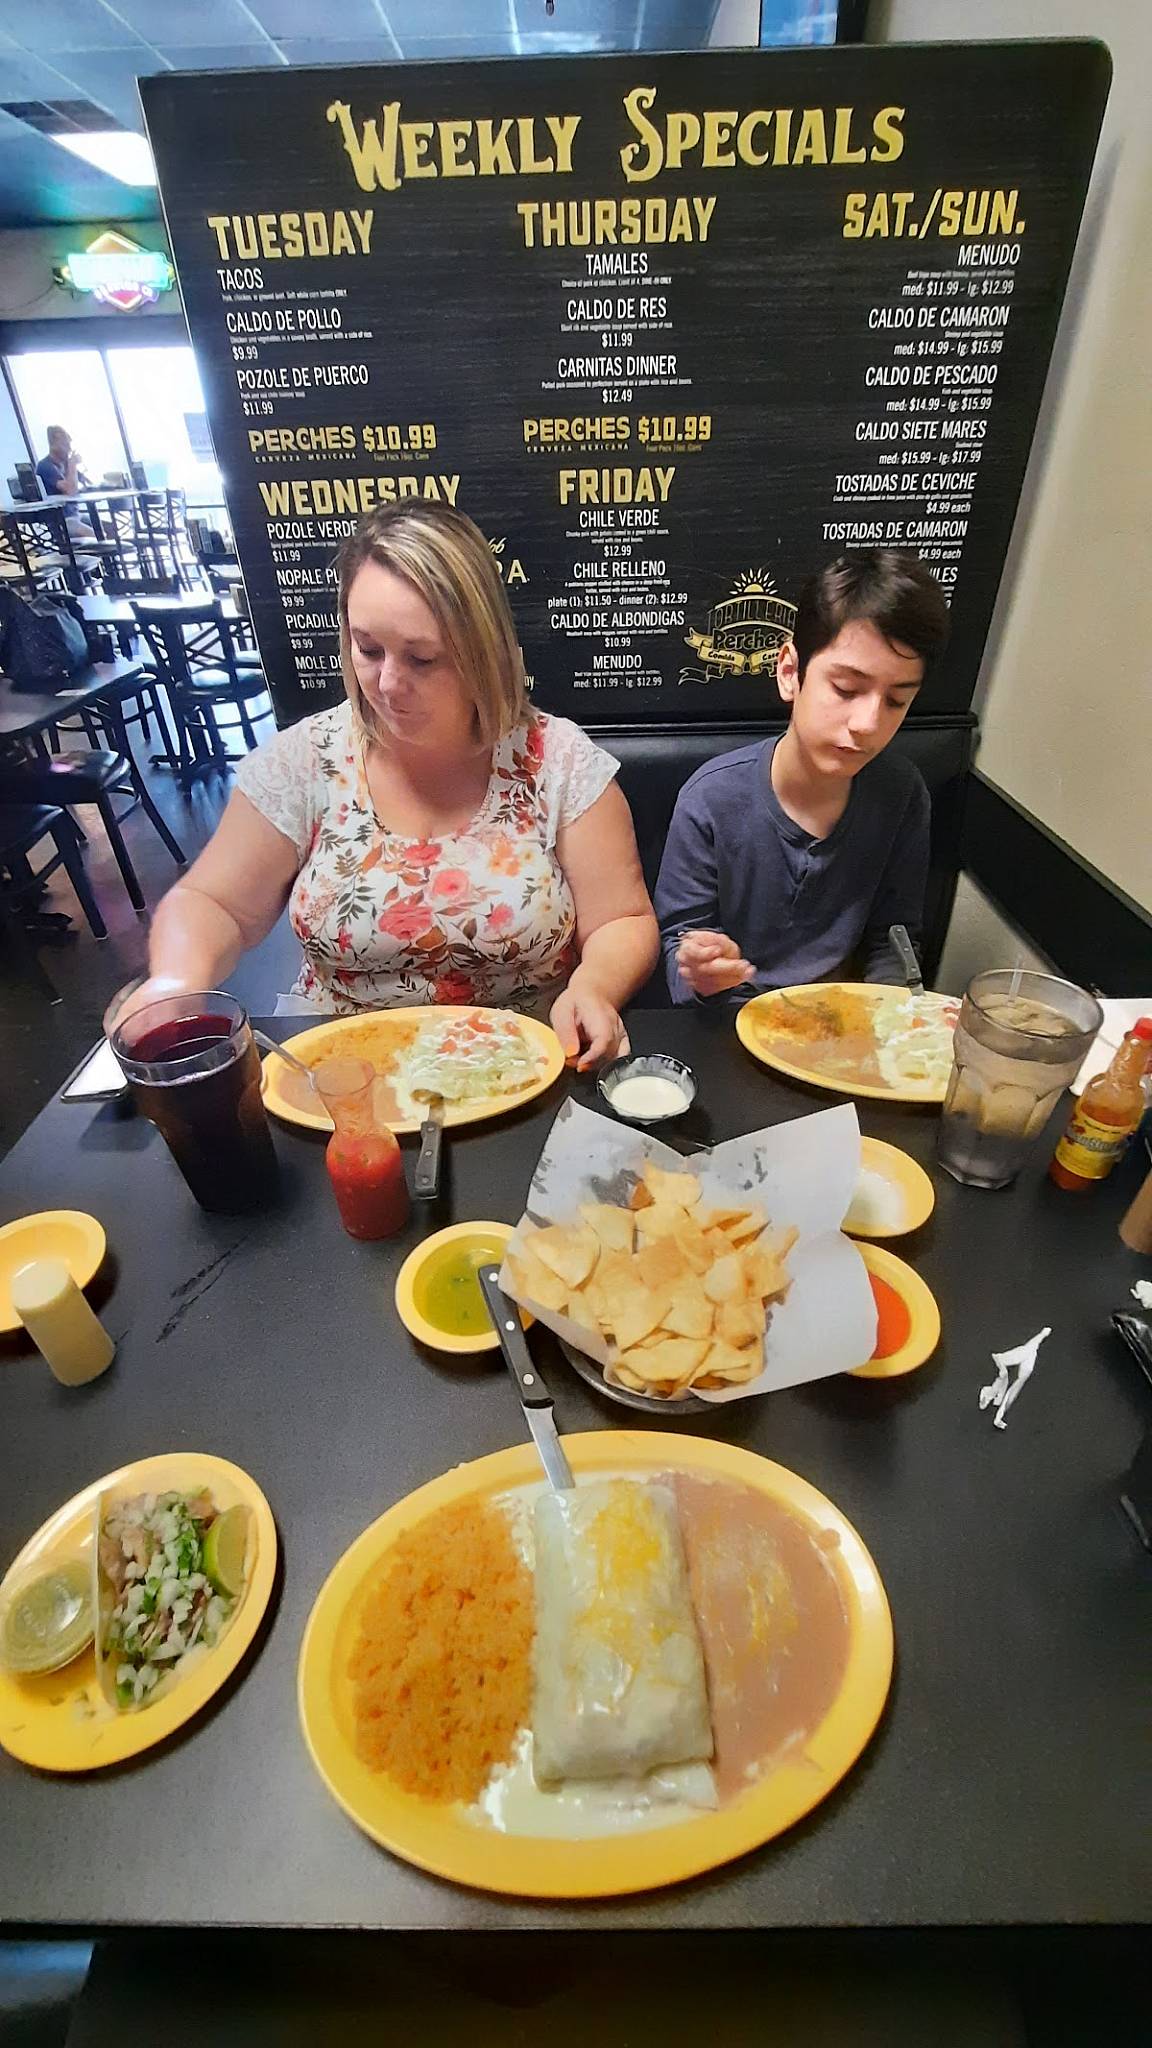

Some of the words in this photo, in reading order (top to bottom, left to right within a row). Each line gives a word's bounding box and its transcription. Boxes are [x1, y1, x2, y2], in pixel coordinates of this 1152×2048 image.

[327, 100, 582, 192] WEEKLY
[620, 86, 905, 183] SPECIALS
[517, 196, 717, 247] THURSDAY
[843, 188, 1026, 239] SAT./SUN.
[207, 210, 374, 260] TUESDAY
[585, 252, 648, 275] TAMALES
[958, 244, 1021, 266] MENUDO
[217, 268, 264, 290] TACOS
[902, 281, 924, 296] med:
[926, 280, 959, 297] $11.99
[981, 279, 1014, 296] $12.99
[567, 299, 613, 320] CALDO
[617, 298, 635, 319] DE
[640, 297, 667, 318] RES
[868, 308, 915, 329] CALDO
[917, 308, 937, 327] DE
[940, 306, 1010, 327] CAMARON
[226, 312, 272, 333] CALDO
[276, 310, 295, 330] DE
[298, 308, 341, 329] POLLO
[602, 332, 633, 348] $11.99
[894, 343, 915, 356] med:
[917, 341, 949, 356] $14.99
[971, 340, 1003, 355] $15.99
[232, 345, 258, 361] $9.99
[558, 356, 622, 378] CARNITAS
[627, 355, 677, 375] DINNER
[866, 367, 910, 386] CALDO
[913, 366, 932, 385] DE
[935, 365, 998, 385] PESCADO
[237, 368, 289, 389] POZOLE
[293, 367, 311, 387] DE
[314, 365, 369, 386] PUERCO
[602, 389, 632, 404] $12.49
[886, 399, 907, 412] med:
[909, 398, 940, 412] $14.99
[961, 397, 992, 411] $15.99
[243, 401, 274, 416] $11.99
[248, 425, 356, 452] PERCHES
[362, 424, 437, 452] $10.99
[523, 416, 631, 442] PERCHES
[638, 416, 711, 443] $10.99
[856, 422, 899, 441] CALDO
[902, 421, 939, 440] SIETE
[941, 420, 987, 439] MARES
[879, 452, 900, 465] med:
[901, 452, 931, 465] $15.99
[951, 451, 981, 464] $17.99
[559, 467, 675, 505] FRIDAY
[835, 474, 898, 493] TOSTADAS
[901, 473, 920, 491] DE
[921, 472, 978, 491] CEVICHE
[258, 475, 460, 516] WEDNESDAY
[926, 502, 950, 514] $4.99
[950, 502, 971, 513] each
[579, 510, 615, 528] CHILE
[619, 509, 659, 526] VERDE
[266, 522, 316, 539] POZOLE
[823, 522, 884, 540] TOSTADAS
[886, 521, 904, 538] DE
[906, 520, 968, 538] CAMARON
[273, 550, 300, 563] $11.99
[604, 545, 632, 558] $12.99
[918, 549, 941, 560] $4.99
[942, 549, 961, 559] each
[276, 568, 323, 586] NOPALE
[573, 562, 608, 578] CHILE
[612, 560, 666, 577] RELLENO
[281, 596, 305, 608] $9.99
[548, 597, 567, 609] plate
[585, 595, 611, 607] $11.50
[619, 595, 643, 605] dinner
[661, 593, 688, 605] $12.99
[551, 613, 589, 630] CALDO
[593, 613, 608, 628] DE
[611, 610, 685, 627] ALBONDIGAS
[291, 639, 313, 649] $9.99
[605, 637, 631, 648] $10.99
[294, 656, 327, 670] MOLE
[593, 654, 642, 670] MENUDO
[300, 679, 326, 690] $10.99
[593, 678, 618, 688] $11.99
[637, 677, 662, 687] $12.99
